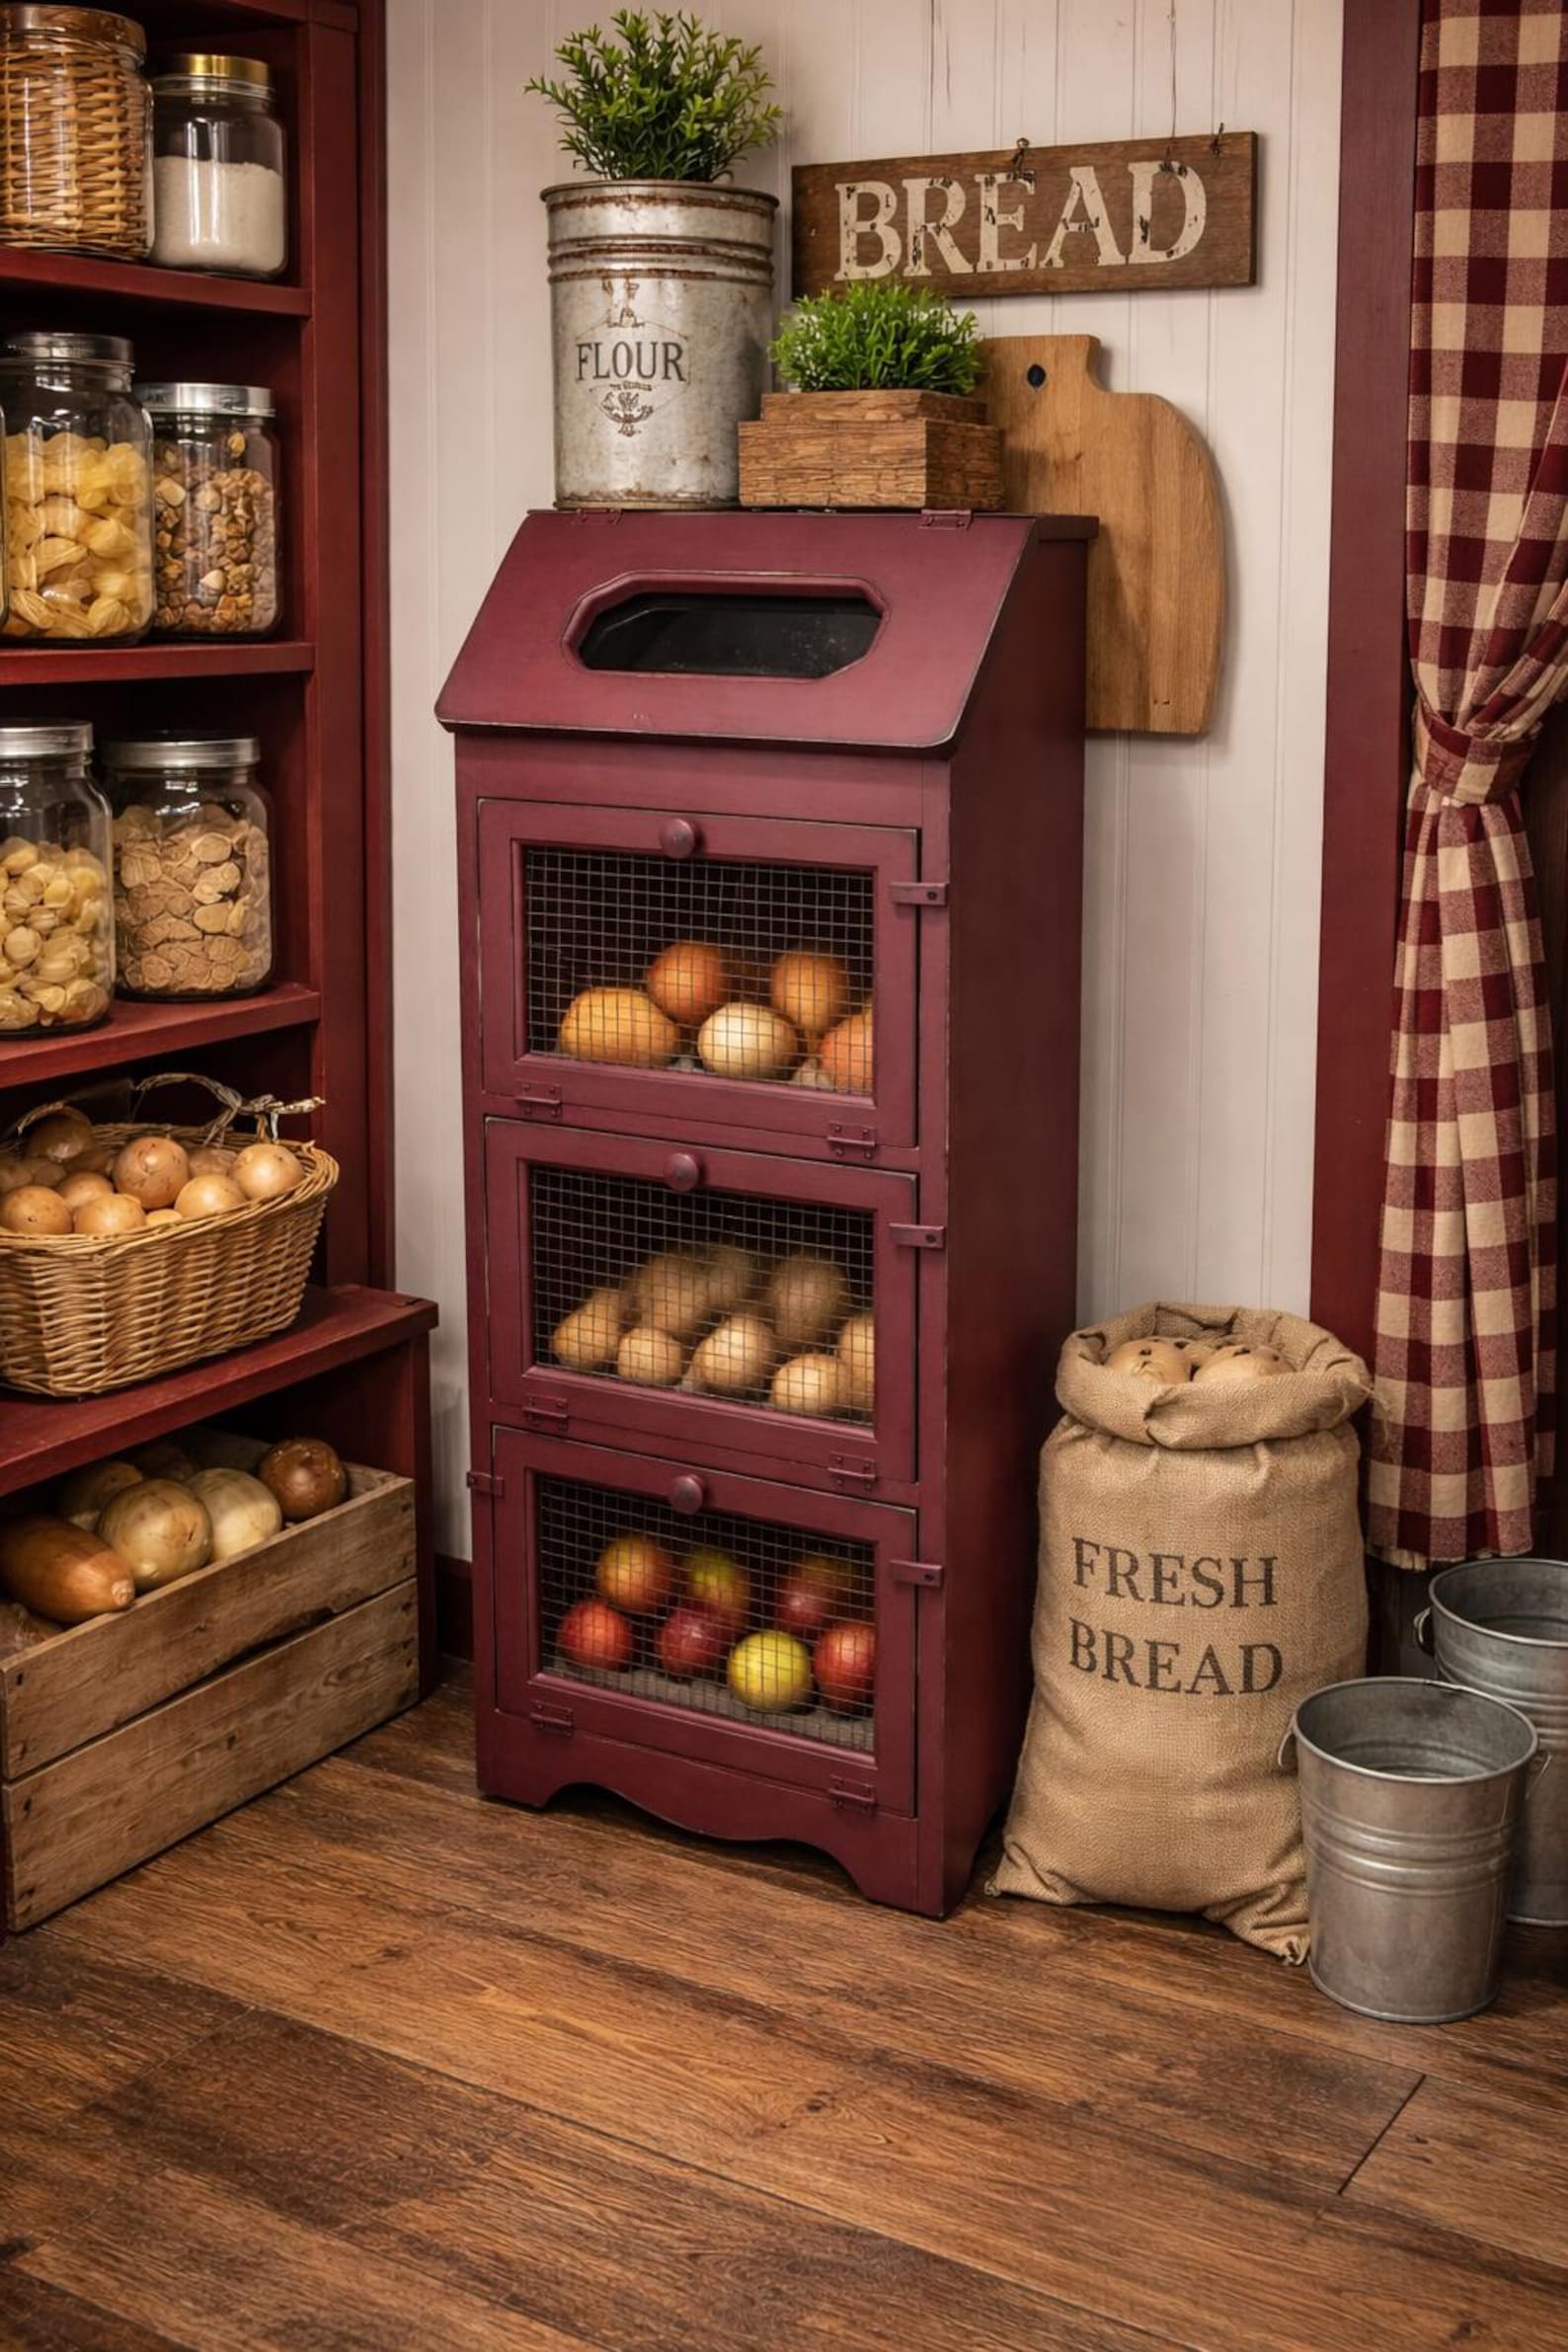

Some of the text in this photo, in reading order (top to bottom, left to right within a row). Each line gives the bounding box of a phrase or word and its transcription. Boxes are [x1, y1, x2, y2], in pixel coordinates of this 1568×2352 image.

[833, 160, 1207, 281] BREAD
[575, 341, 687, 382] FLOUR
[1071, 1536, 1278, 1608] FRESH
[1068, 1616, 1284, 1695] BREAD
